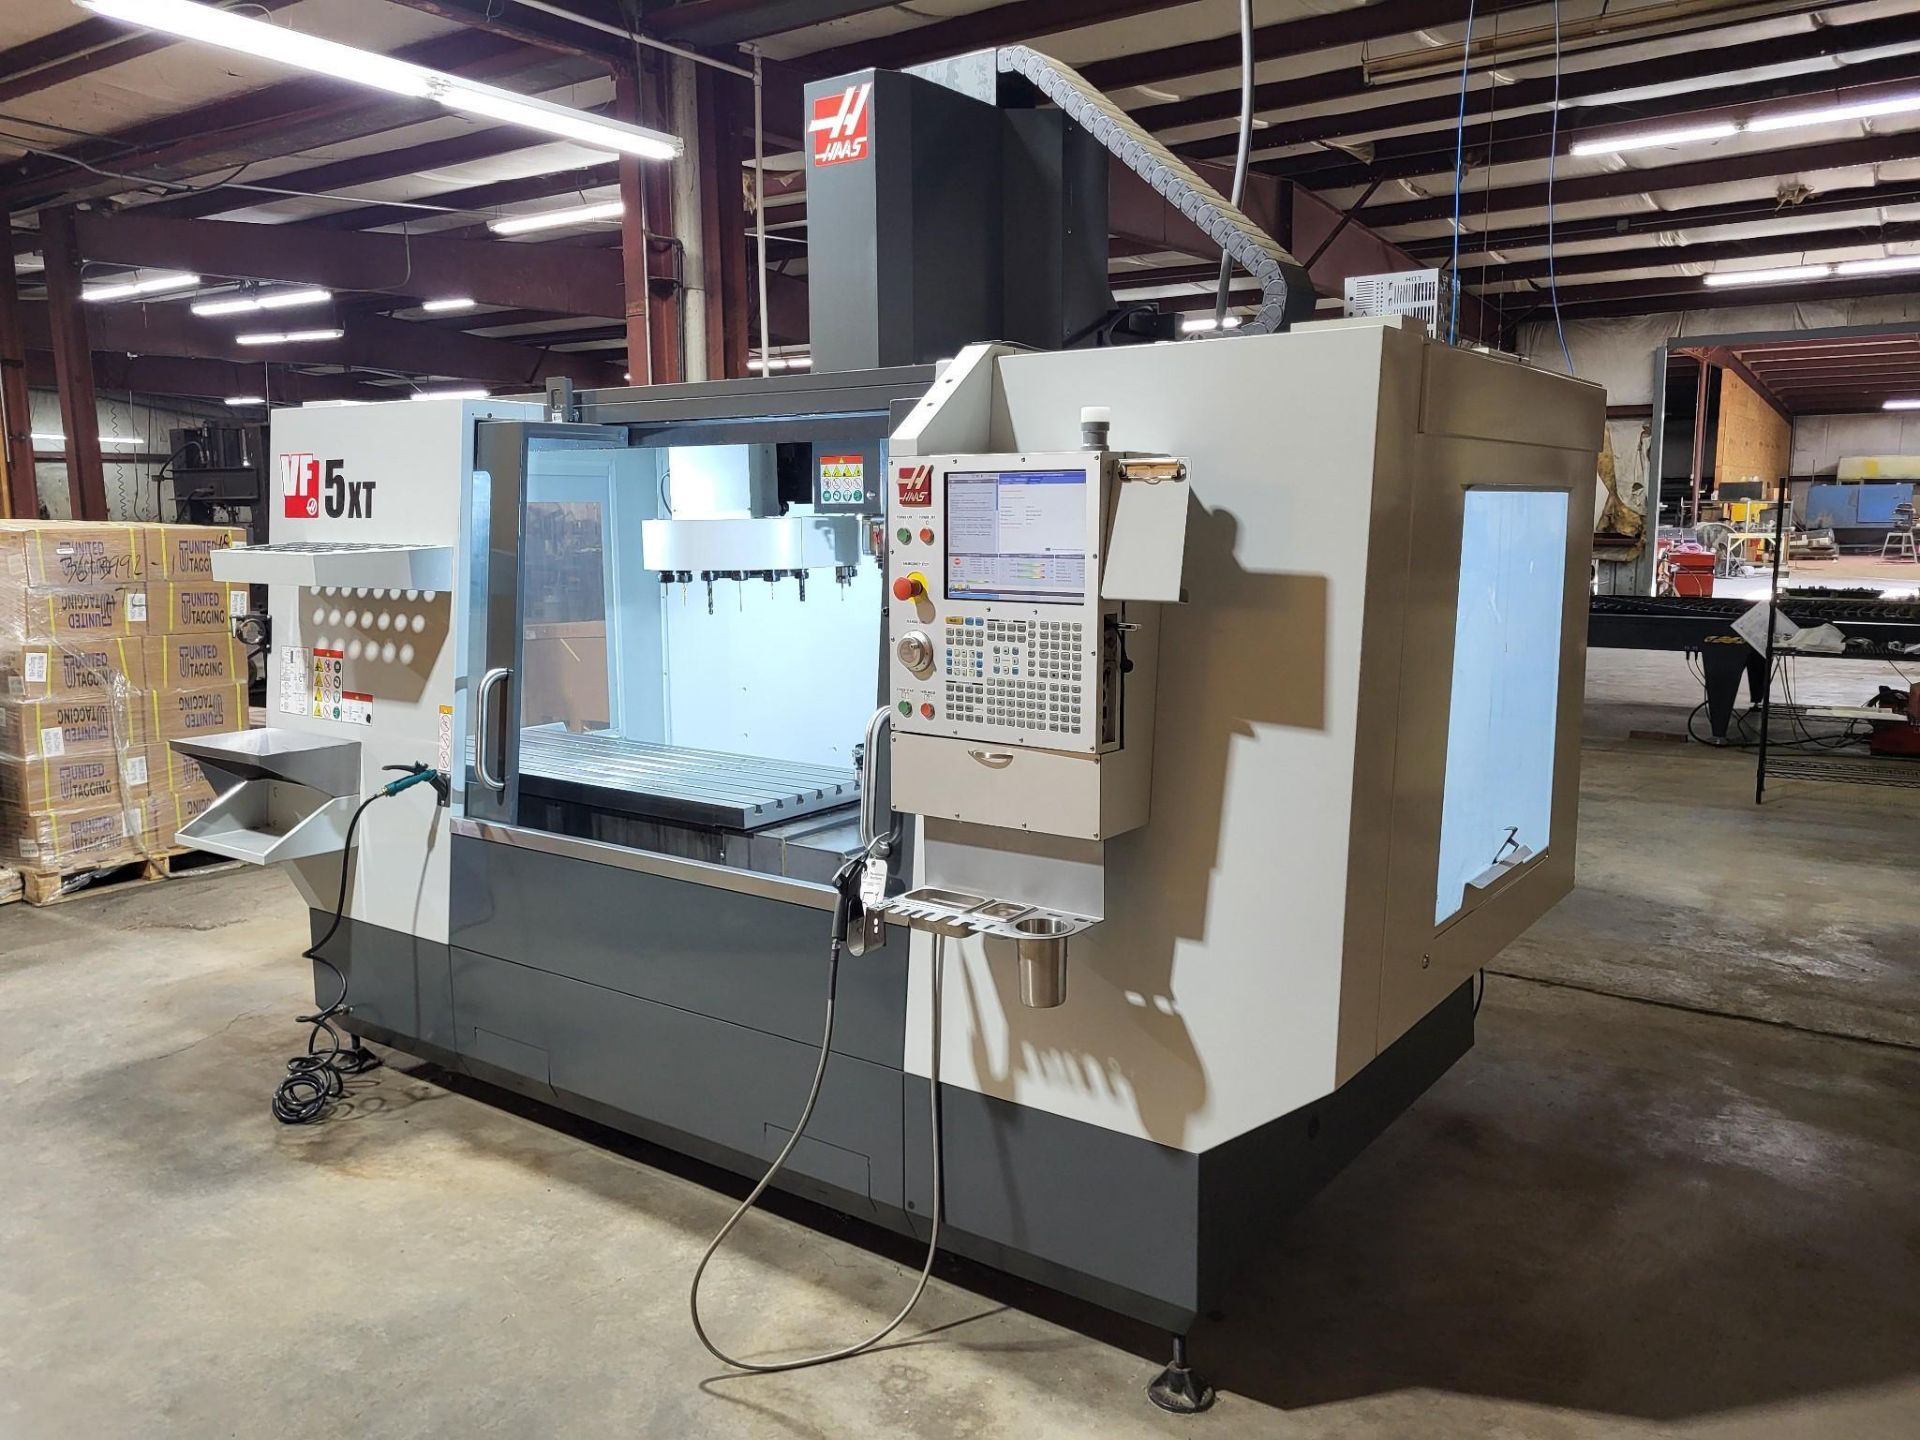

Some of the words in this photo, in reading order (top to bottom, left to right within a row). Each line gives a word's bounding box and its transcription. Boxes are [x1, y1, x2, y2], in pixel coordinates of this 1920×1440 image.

[815, 136, 868, 162] HAAS
[280, 453, 313, 497] VF
[899, 491, 928, 502] HAAS
[72, 541, 105, 556] UNITED
[189, 558, 212, 573] TAGGI
[61, 594, 101, 611] TAGGING
[191, 592, 219, 607] UNITED
[68, 612, 102, 629] UNITED
[191, 610, 225, 625] TAGGING
[189, 645, 218, 660] UNITED
[189, 662, 223, 678] TAGGING
[178, 694, 213, 711] TAGGING
[57, 706, 97, 725] TAGGING
[184, 712, 213, 728] UNITED
[64, 726, 98, 743] UNITED
[70, 763, 105, 780] UNITED
[71, 780, 112, 799] TAGGING
